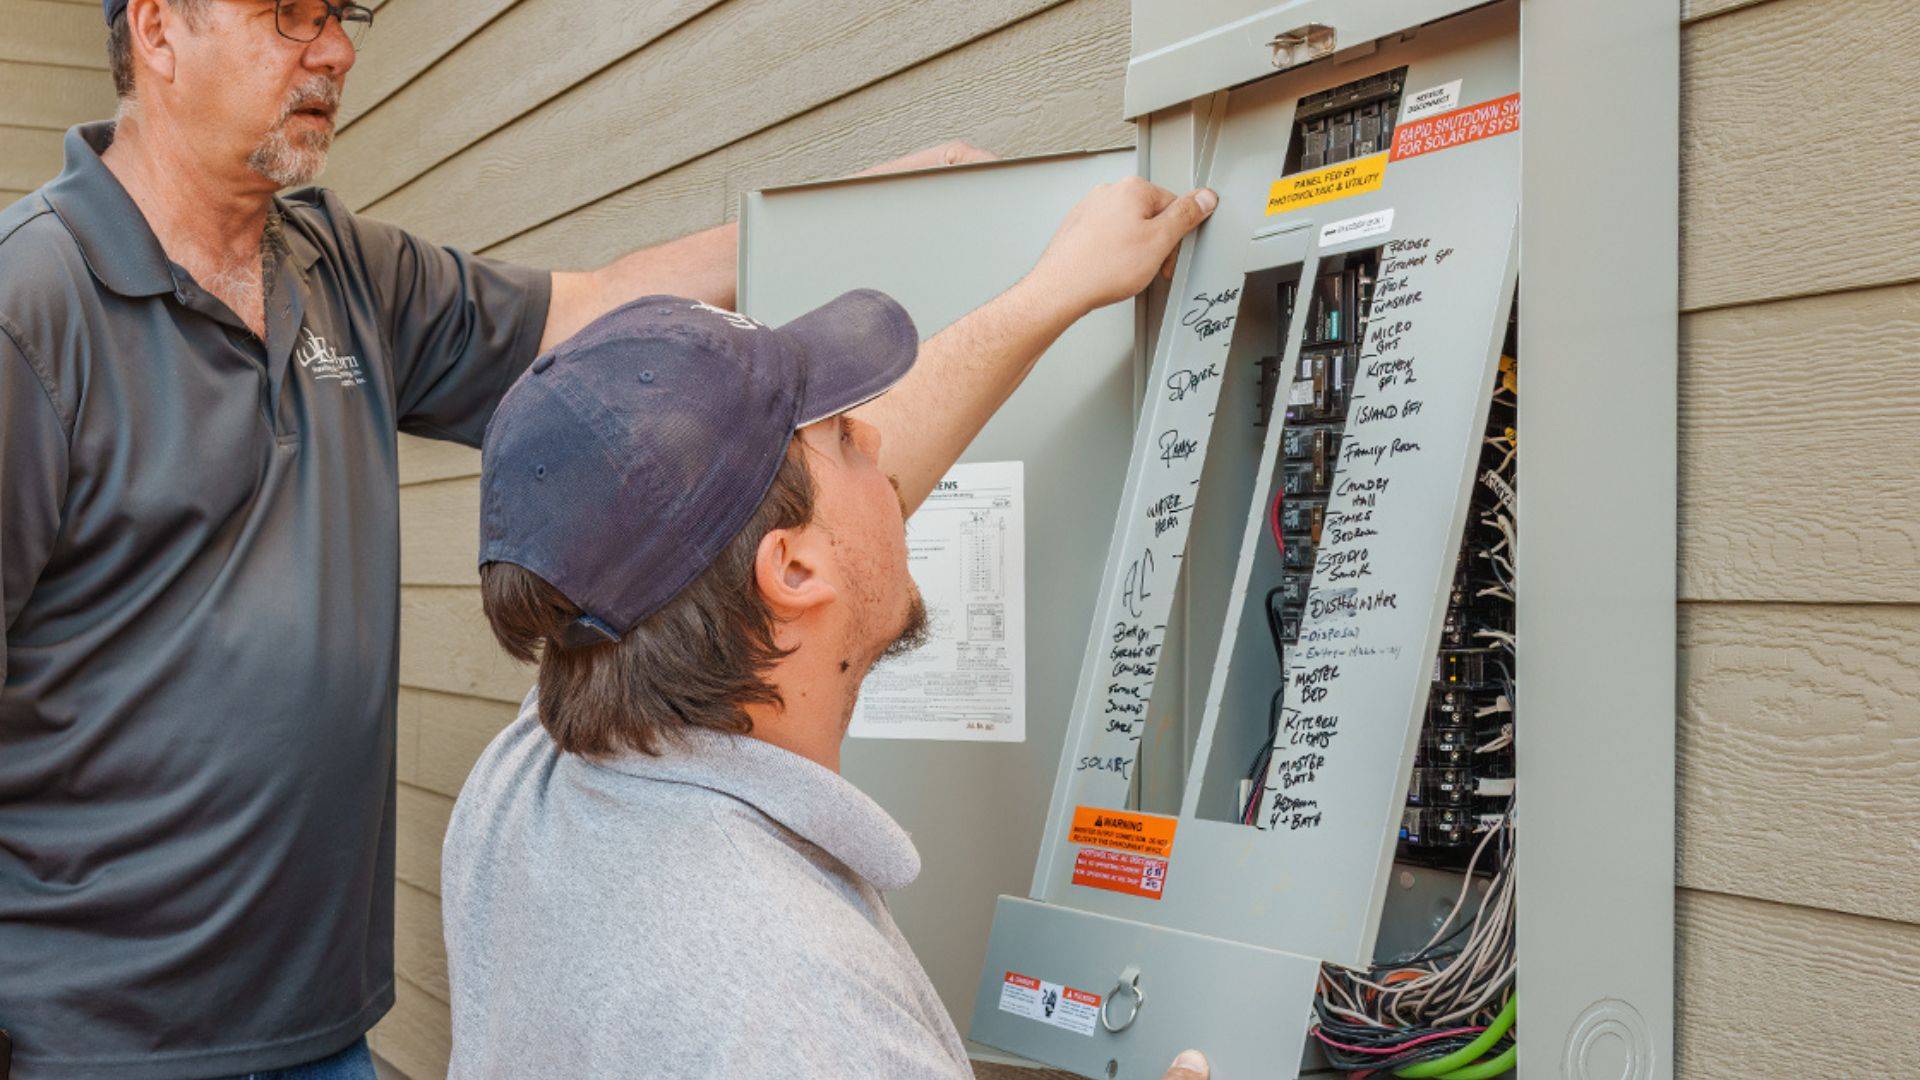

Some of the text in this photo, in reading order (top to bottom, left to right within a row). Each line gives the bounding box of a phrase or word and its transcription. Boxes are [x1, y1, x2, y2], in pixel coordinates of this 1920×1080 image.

[1400, 123, 1433, 143] RAPID
[1434, 104, 1500, 135] SHUTDOWN
[1397, 139, 1422, 158] FOR
[1424, 128, 1467, 151] SOLAR
[1468, 122, 1486, 140] PV
[1294, 166, 1358, 189] PANEL FED BY
[1336, 182, 1343, 192] &
[1345, 173, 1380, 190] UTILITY
[1375, 291, 1422, 314] WASHER
[1371, 321, 1412, 343] MICRO
[1366, 357, 1415, 378] KITCHEN
[1405, 368, 1417, 385] 2
[1295, 665, 1340, 687] MASTER
[1301, 685, 1328, 704] BED
[1104, 817, 1143, 832] WARNING
